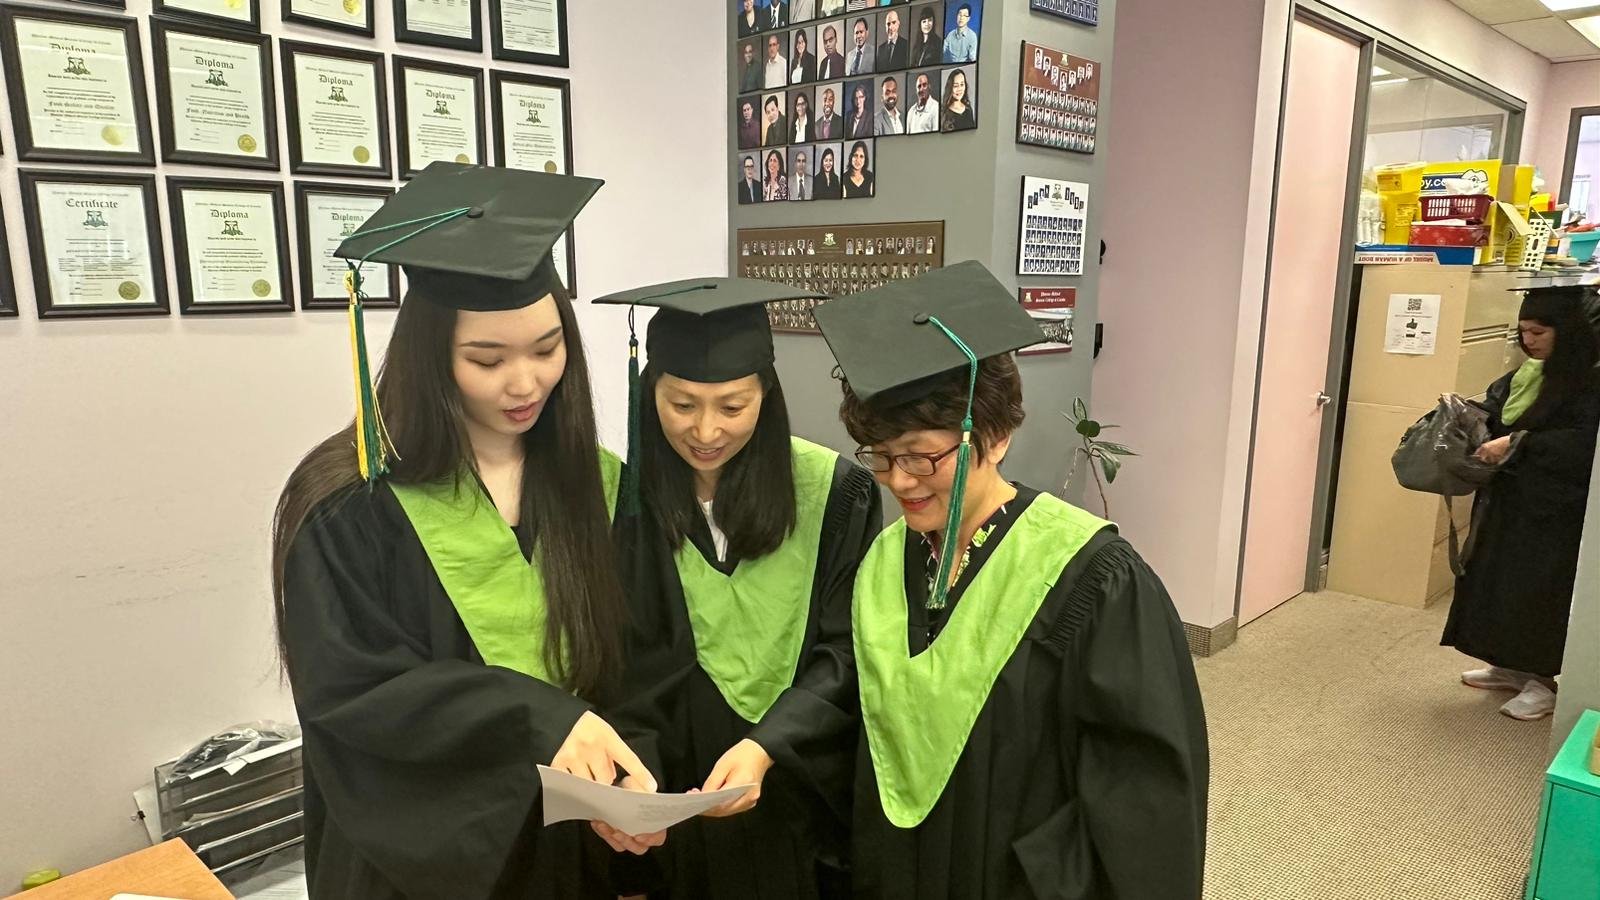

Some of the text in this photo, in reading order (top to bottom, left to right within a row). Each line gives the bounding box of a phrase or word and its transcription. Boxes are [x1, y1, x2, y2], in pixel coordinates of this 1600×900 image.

[194, 55, 234, 69] Diploma
[318, 73, 354, 86] Diploma
[425, 89, 456, 101] Diploma
[519, 99, 546, 109] Diploma
[65, 198, 119, 209] Certificate
[210, 209, 249, 218] Diploma
[331, 212, 365, 222] Diploma
